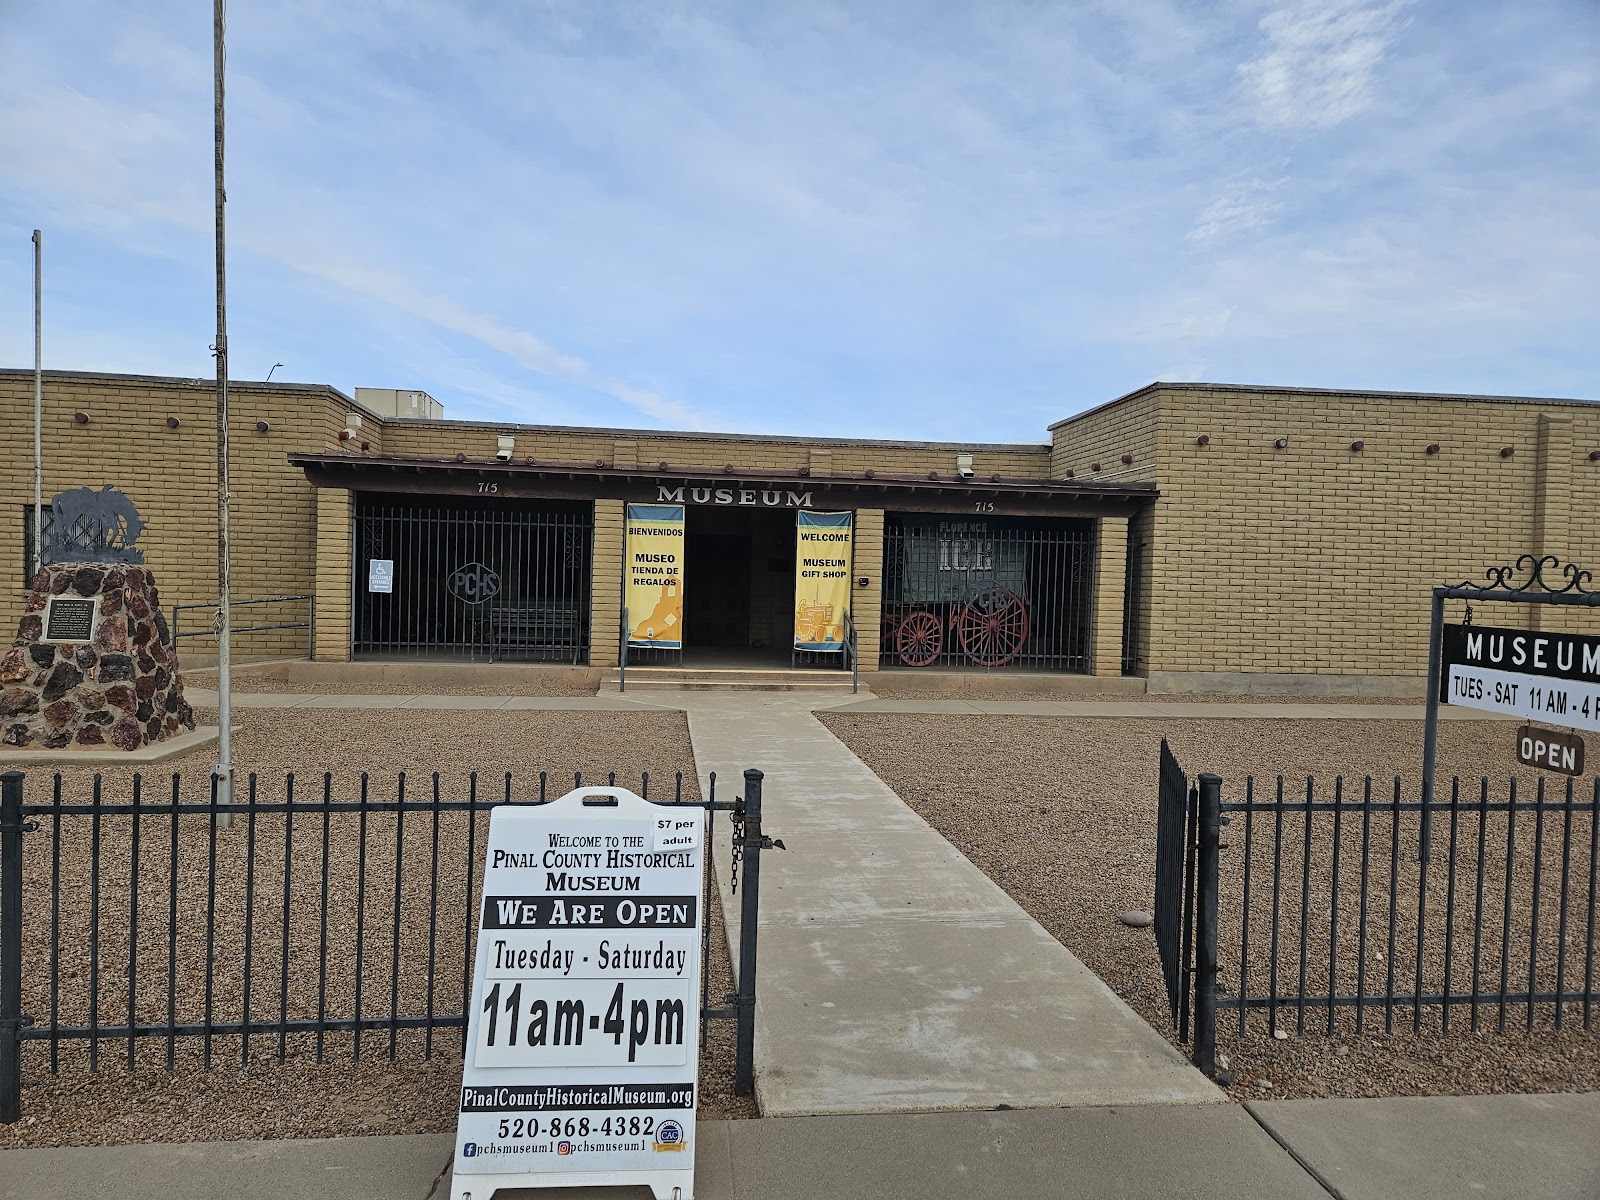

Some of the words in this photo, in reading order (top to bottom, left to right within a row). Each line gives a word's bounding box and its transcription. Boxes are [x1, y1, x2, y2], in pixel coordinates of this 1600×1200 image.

[477, 482, 498, 493] 715
[656, 485, 814, 507] MUSEUM
[975, 501, 994, 512] 715
[628, 527, 683, 537] BIENVENIDOS
[800, 532, 850, 542] WELCOME
[635, 553, 676, 563] MUSEO
[802, 558, 846, 567] MUSEUM
[631, 566, 664, 575] TIENDA
[666, 566, 679, 575] DE
[801, 570, 821, 578] GIFT
[822, 570, 847, 579] SHOP
[633, 578, 677, 587] REGALOS
[1466, 632, 1600, 676] MUSEUM
[1454, 675, 1483, 700] TUES
[1495, 682, 1518, 706] SAT
[1529, 687, 1541, 710] 11
[1546, 690, 1567, 715] AM
[1581, 695, 1590, 718] 4
[1521, 737, 1575, 771] OPEN
[657, 819, 672, 829] $7
[675, 820, 695, 830] per
[548, 833, 602, 848] WELCOME
[605, 837, 619, 847] TO
[622, 836, 644, 847] THE
[662, 836, 693, 845] adult
[492, 850, 538, 868] PINAL
[542, 850, 602, 869] COUNTY
[606, 850, 695, 869] HISTORICAL
[545, 872, 641, 892] MUSEUM
[496, 900, 538, 925] WE
[549, 900, 605, 925] ARE
[616, 900, 688, 925] OPEN
[494, 940, 575, 976] Tuesday
[598, 940, 686, 976] Saturday
[483, 982, 684, 1063] 11am-4pm
[462, 1086, 692, 1110] PinalCountyHistoricalMuseum.org
[498, 1116, 654, 1139] 520-868-4382
[661, 1131, 679, 1140] CAC
[476, 1141, 554, 1157] pchsmuseum1
[570, 1139, 646, 1155] pchsmuseum1
